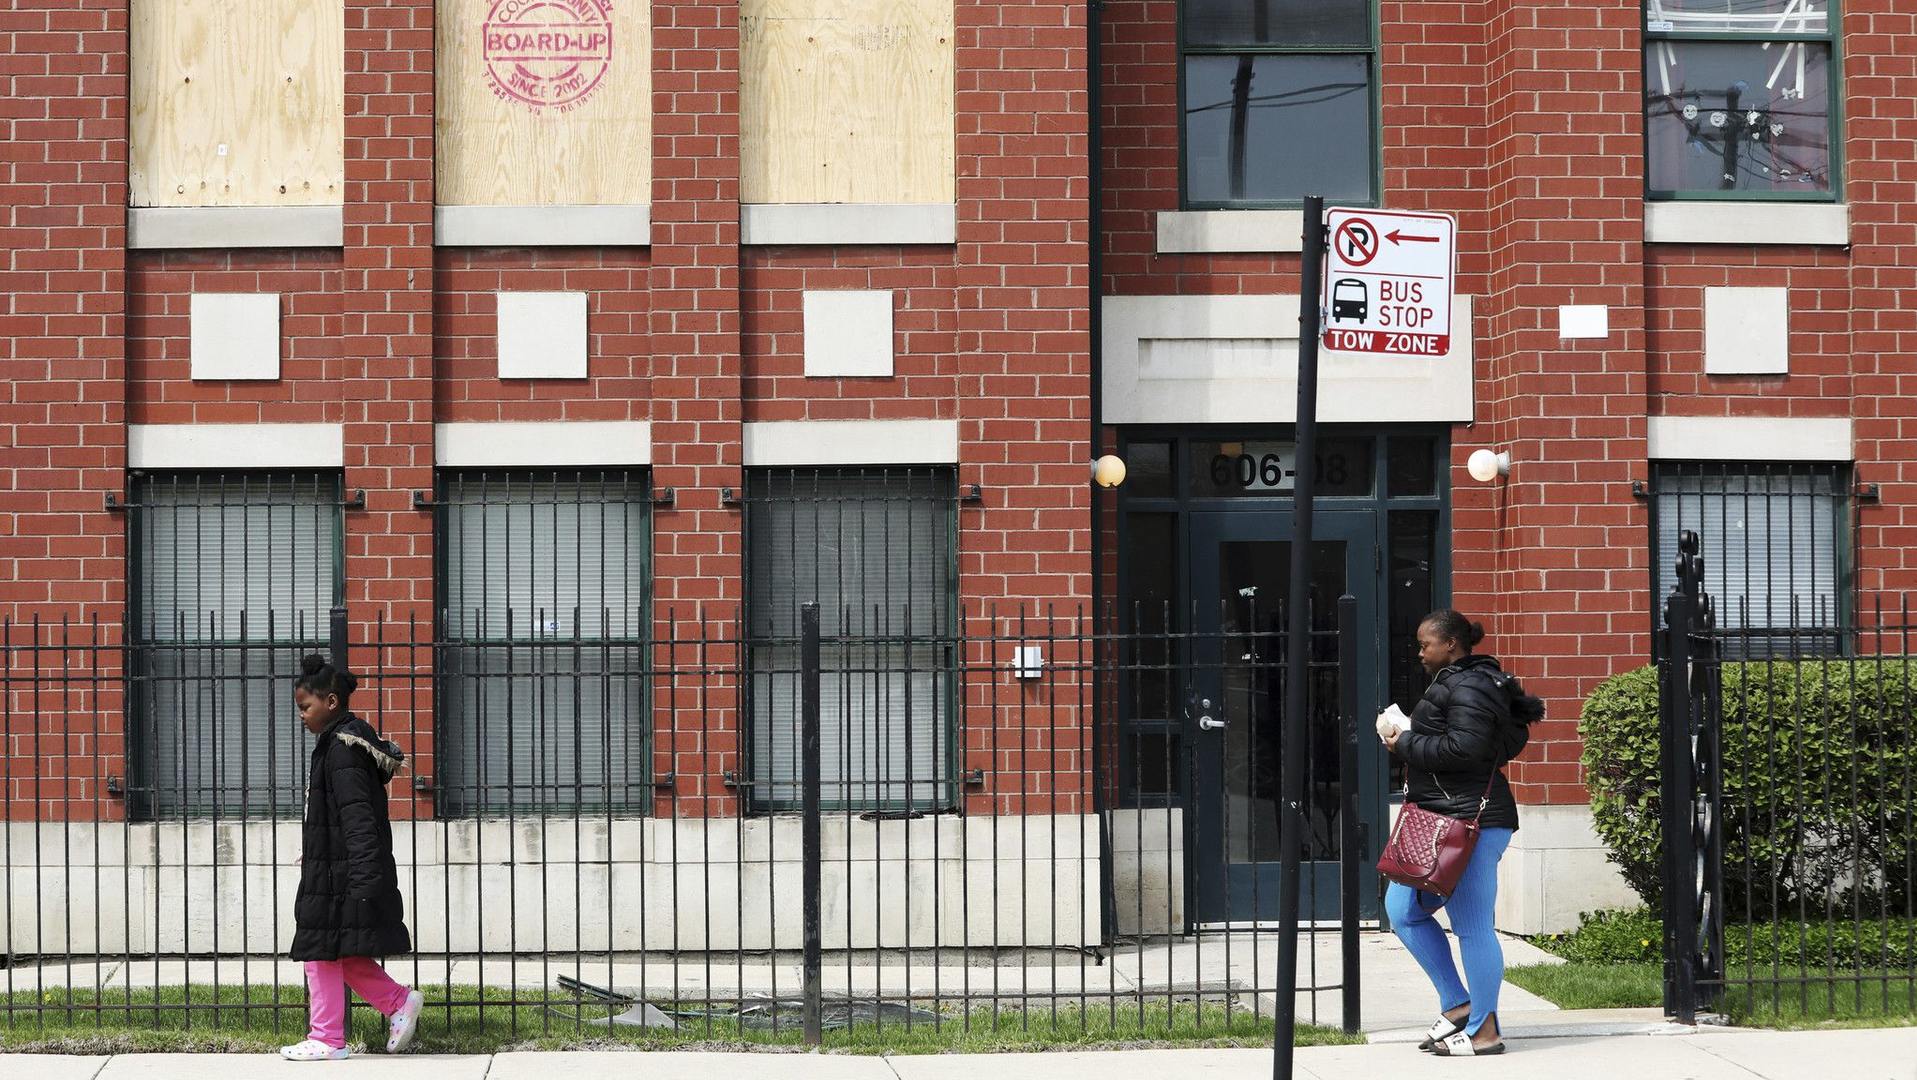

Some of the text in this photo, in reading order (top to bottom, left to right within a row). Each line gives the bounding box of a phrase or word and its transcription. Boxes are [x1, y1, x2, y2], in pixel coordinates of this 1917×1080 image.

[487, 33, 607, 51] BOARD-UP
[507, 72, 547, 98] SINCE
[554, 73, 588, 98] 2002
[1380, 280, 1422, 303] BUS
[1379, 305, 1433, 328] STOP
[1331, 331, 1438, 354] TOW ZONE
